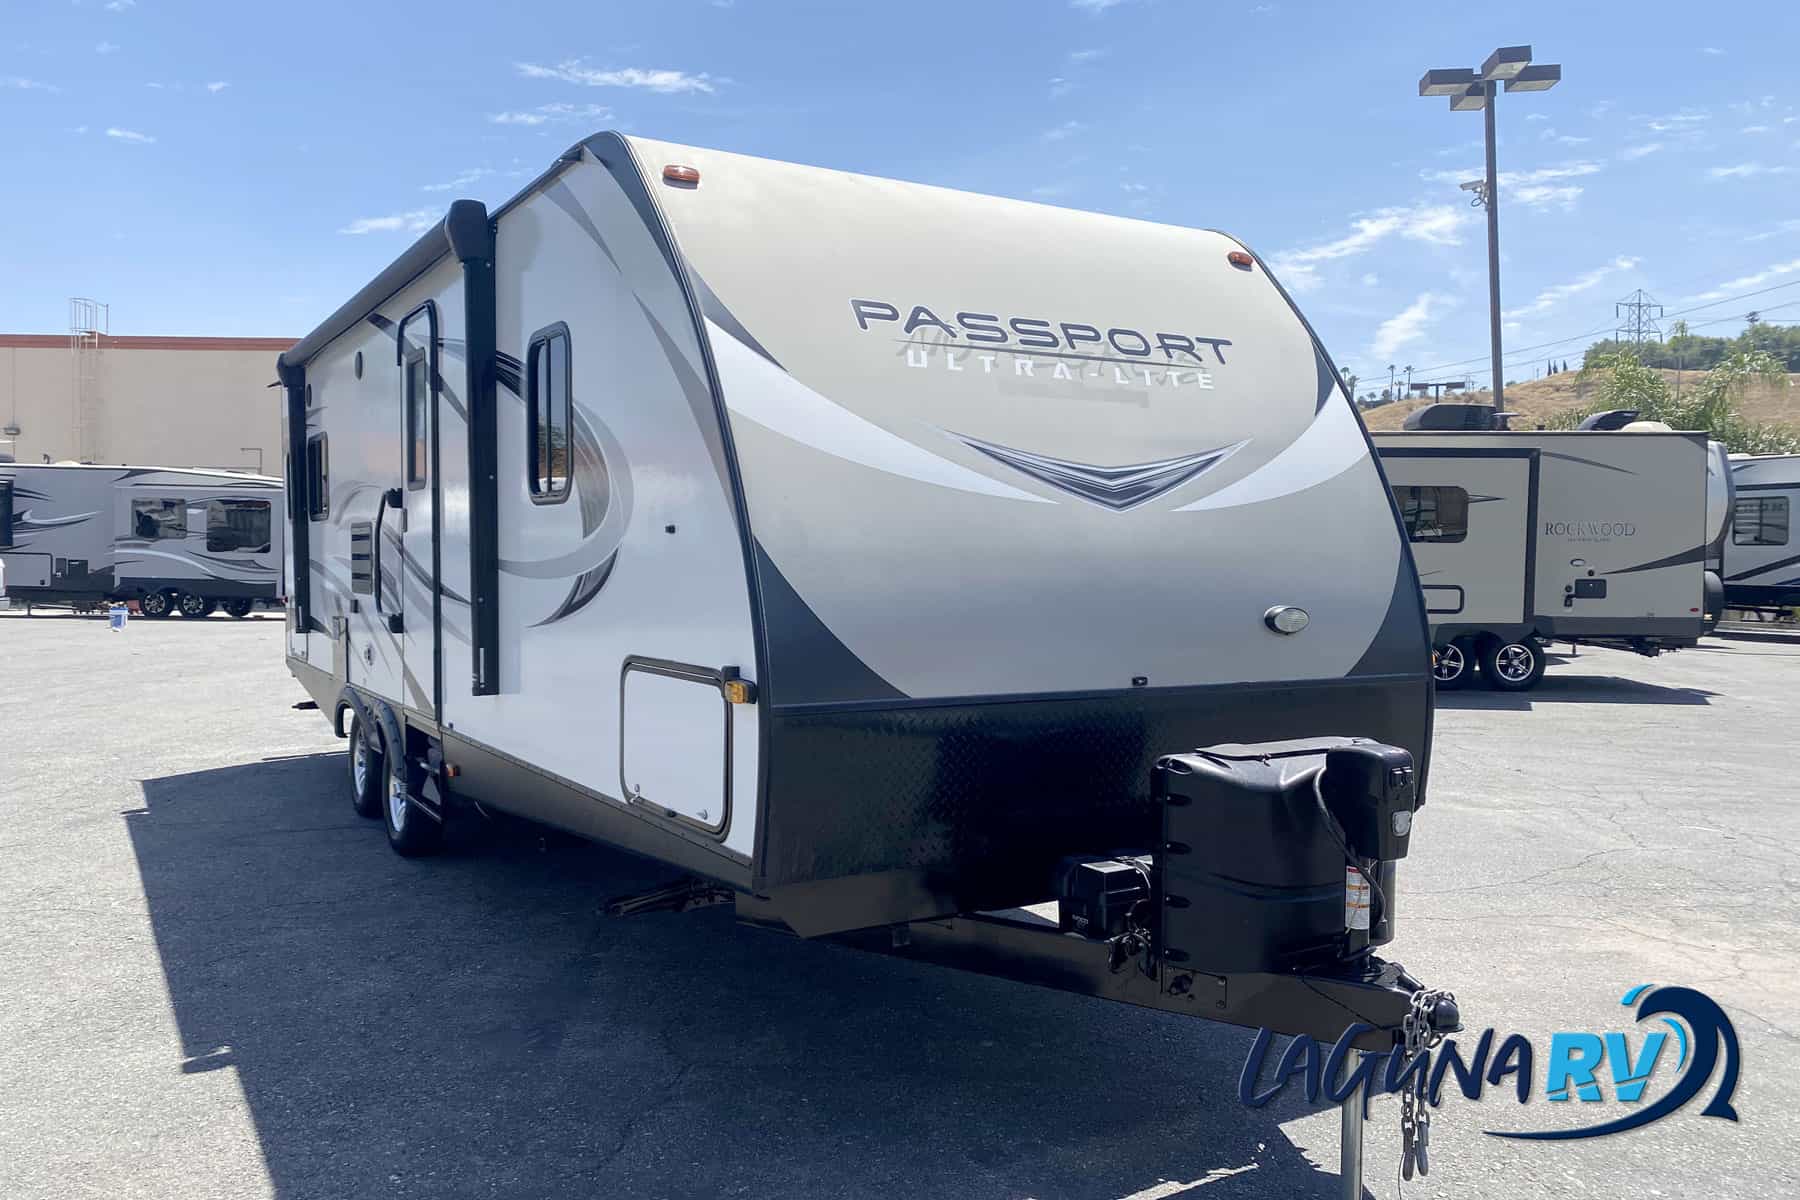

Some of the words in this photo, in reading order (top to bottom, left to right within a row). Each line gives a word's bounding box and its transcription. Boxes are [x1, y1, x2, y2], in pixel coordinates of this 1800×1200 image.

[850, 298, 1232, 364] PASSPORT
[906, 350, 1215, 391] ULTRA-LITE
[1544, 521, 1636, 536] ROCKWOOD
